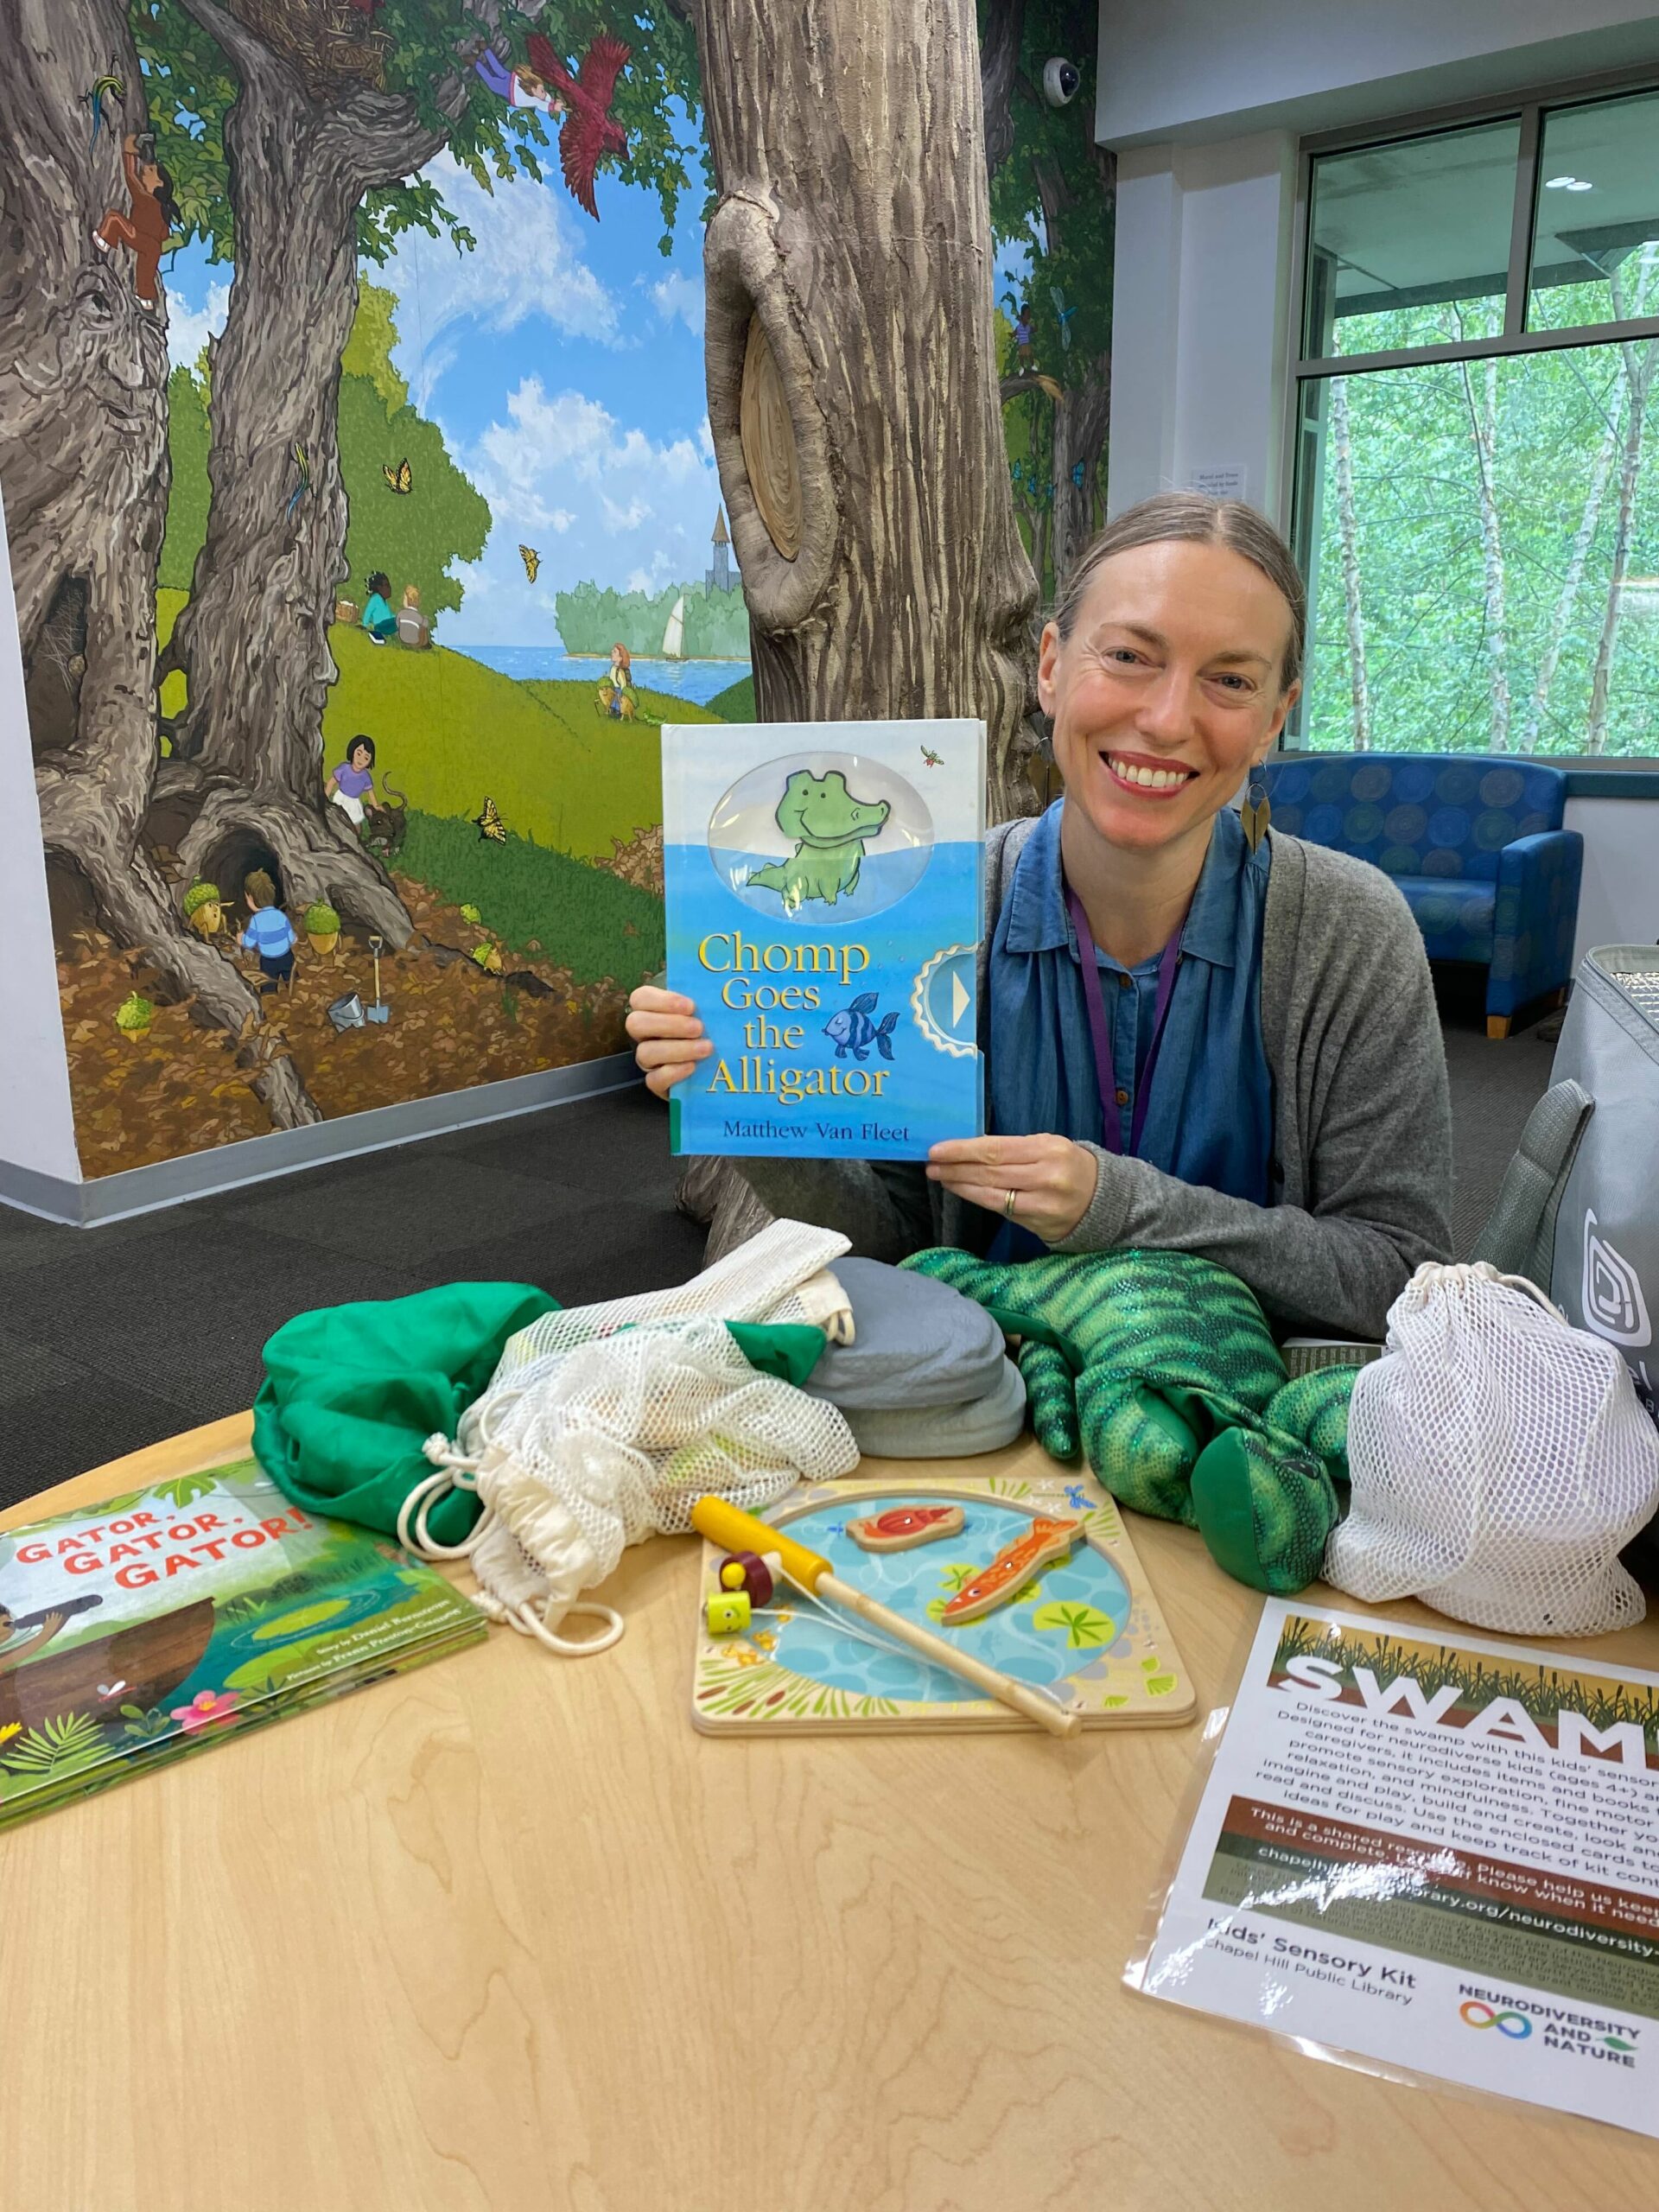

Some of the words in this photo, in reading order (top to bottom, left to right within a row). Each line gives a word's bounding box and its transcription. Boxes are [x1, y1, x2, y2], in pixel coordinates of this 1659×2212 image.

[698, 931, 870, 986] Chomp
[721, 978, 821, 1011] Goes
[743, 1014, 805, 1050] the
[706, 1056, 890, 1105] Alligator
[723, 1120, 807, 1139] Matthew
[816, 1122, 852, 1140] Van
[861, 1122, 910, 1141] Fleet
[16, 1511, 175, 1565] GATOR,
[63, 1513, 243, 1575] GATOR,
[114, 1507, 313, 1590] GATOR!
[353, 1622, 391, 1642] Daniel
[1278, 1655, 1659, 1770] SWAM
[1296, 1701, 1367, 1723] Discover
[1373, 1719, 1398, 1731] the
[1405, 1727, 1465, 1745] swamp
[1471, 1741, 1507, 1754] with
[1515, 1750, 1544, 1763] this
[1551, 1757, 1590, 1772] kids'
[1277, 1710, 1354, 1733] Designed
[1360, 1728, 1382, 1740] for
[1389, 1736, 1501, 1766] neurodiverse
[1507, 1760, 1541, 1776] kids
[1548, 1770, 1599, 1788] (ages
[1605, 1783, 1637, 1797] 4+)
[1289, 1739, 1361, 1762] promote
[1368, 1758, 1434, 1779] sensory
[1440, 1774, 1548, 1805] exploration,
[1555, 1798, 1588, 1813] fine
[1595, 1808, 1652, 1827] motor
[1305, 1731, 1395, 1758] caregivers,
[1402, 1751, 1410, 1759] it
[1419, 1755, 1490, 1777] includes
[1497, 1771, 1545, 1789] items
[1552, 1786, 1585, 1799] and
[1592, 1793, 1649, 1813] books
[1255, 1771, 1294, 1785] read
[1300, 1783, 1332, 1795] and
[1338, 1790, 1406, 1812] discuss.
[1414, 1807, 1446, 1821] Use
[1453, 1816, 1482, 1830] the
[1489, 1827, 1573, 1853] enclosed
[1580, 1848, 1634, 1866] cards
[1263, 1758, 1330, 1781] imagine
[1336, 1777, 1368, 1789] and
[1374, 1786, 1414, 1802] play,
[1422, 1795, 1466, 1812] build
[1472, 1809, 1507, 1821] and
[1513, 1818, 1577, 1840] create,
[1585, 1832, 1624, 1849] look
[1632, 1846, 1659, 1861] an
[1287, 1752, 1375, 1779] relaxation,
[1382, 1775, 1414, 1787] and
[1421, 1783, 1534, 1815] mindfulness.
[1543, 1808, 1627, 1834] Together
[1253, 1808, 1283, 1822] This
[1289, 1817, 1301, 1827] is
[1324, 1827, 1382, 1847] shared
[1478, 1863, 1536, 1885] Please
[1543, 1879, 1584, 1897] help
[1591, 1892, 1611, 1904] us
[1283, 1789, 1328, 1808] ideas
[1335, 1802, 1357, 1815] for
[1366, 1811, 1403, 1826] play
[1410, 1822, 1444, 1835] and
[1452, 1829, 1497, 1848] keep
[1503, 1842, 1550, 1860] track
[1558, 1858, 1578, 1867] of
[1585, 1861, 1608, 1875] kit
[1265, 1822, 1297, 1835] and
[1302, 1832, 1389, 1859] complete.
[1478, 1872, 1528, 1893] know
[1535, 1889, 1585, 1909] when
[1592, 1902, 1605, 1913] it
[1264, 1954, 1289, 1969] Hill
[1294, 1962, 1344, 1986] Public
[1351, 1979, 1412, 2005] Library
[1273, 1937, 1371, 1977] Sensory
[1381, 1967, 1415, 1988] Kit
[1459, 1984, 1640, 2039] NEURODIVERSITY
[1544, 2023, 1591, 2042] AND
[1544, 2035, 1634, 2068] NATURE
